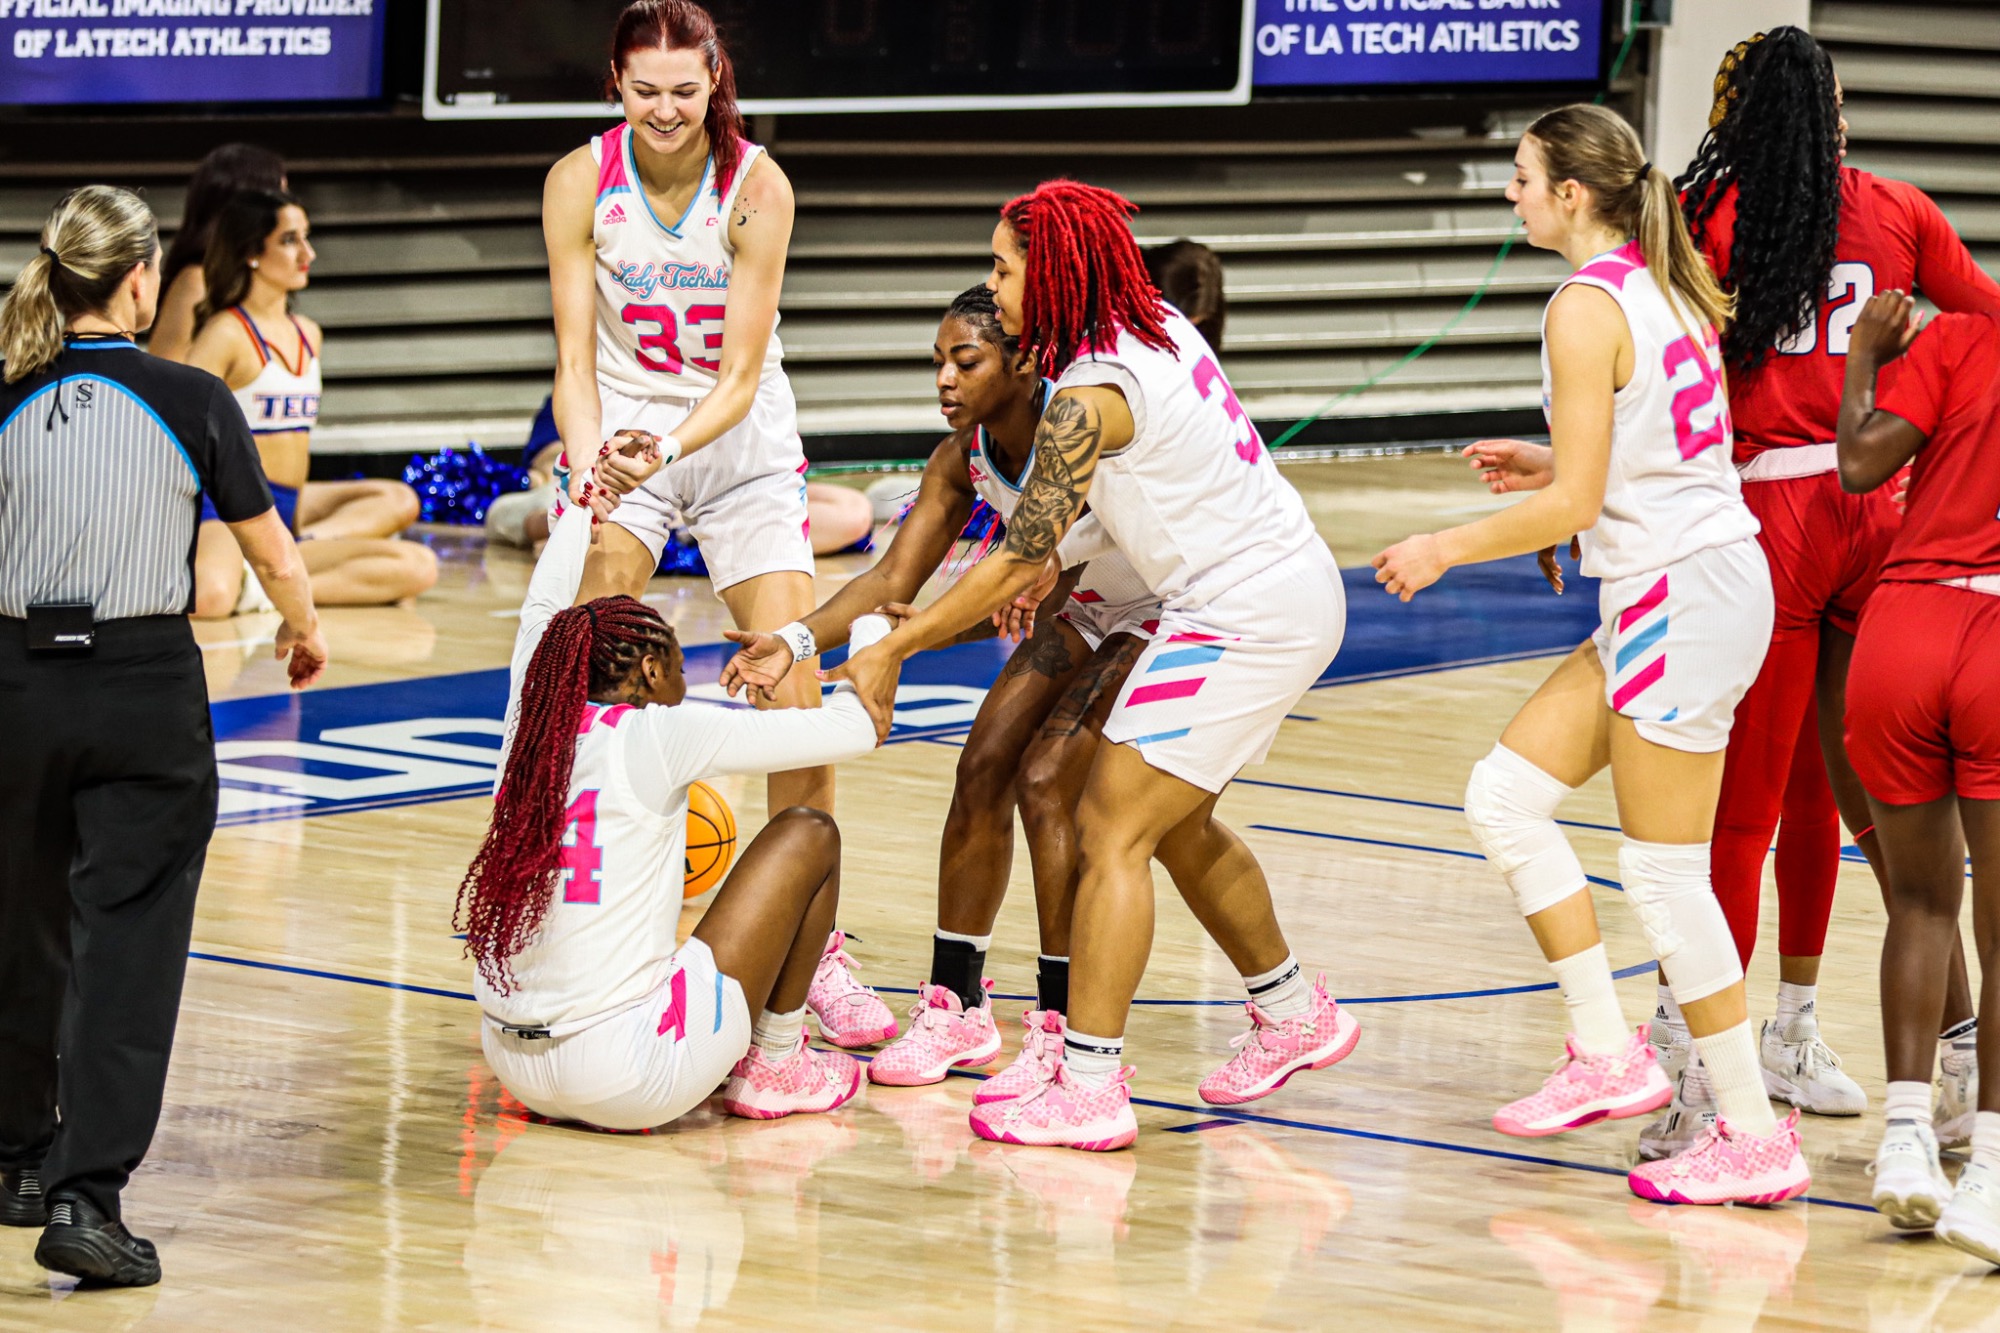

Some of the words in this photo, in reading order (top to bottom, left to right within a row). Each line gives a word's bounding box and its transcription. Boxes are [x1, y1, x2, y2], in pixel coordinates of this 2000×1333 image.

[13, 28, 52, 58] OF
[170, 26, 331, 56] ATHLETICS
[1256, 23, 1301, 57] OF
[1305, 23, 1344, 55] LA
[1346, 21, 1426, 55] TECH
[1428, 19, 1580, 53] ATHLETICS
[609, 260, 660, 301] Lady
[621, 302, 726, 376] 33
[557, 787, 604, 906] 4
